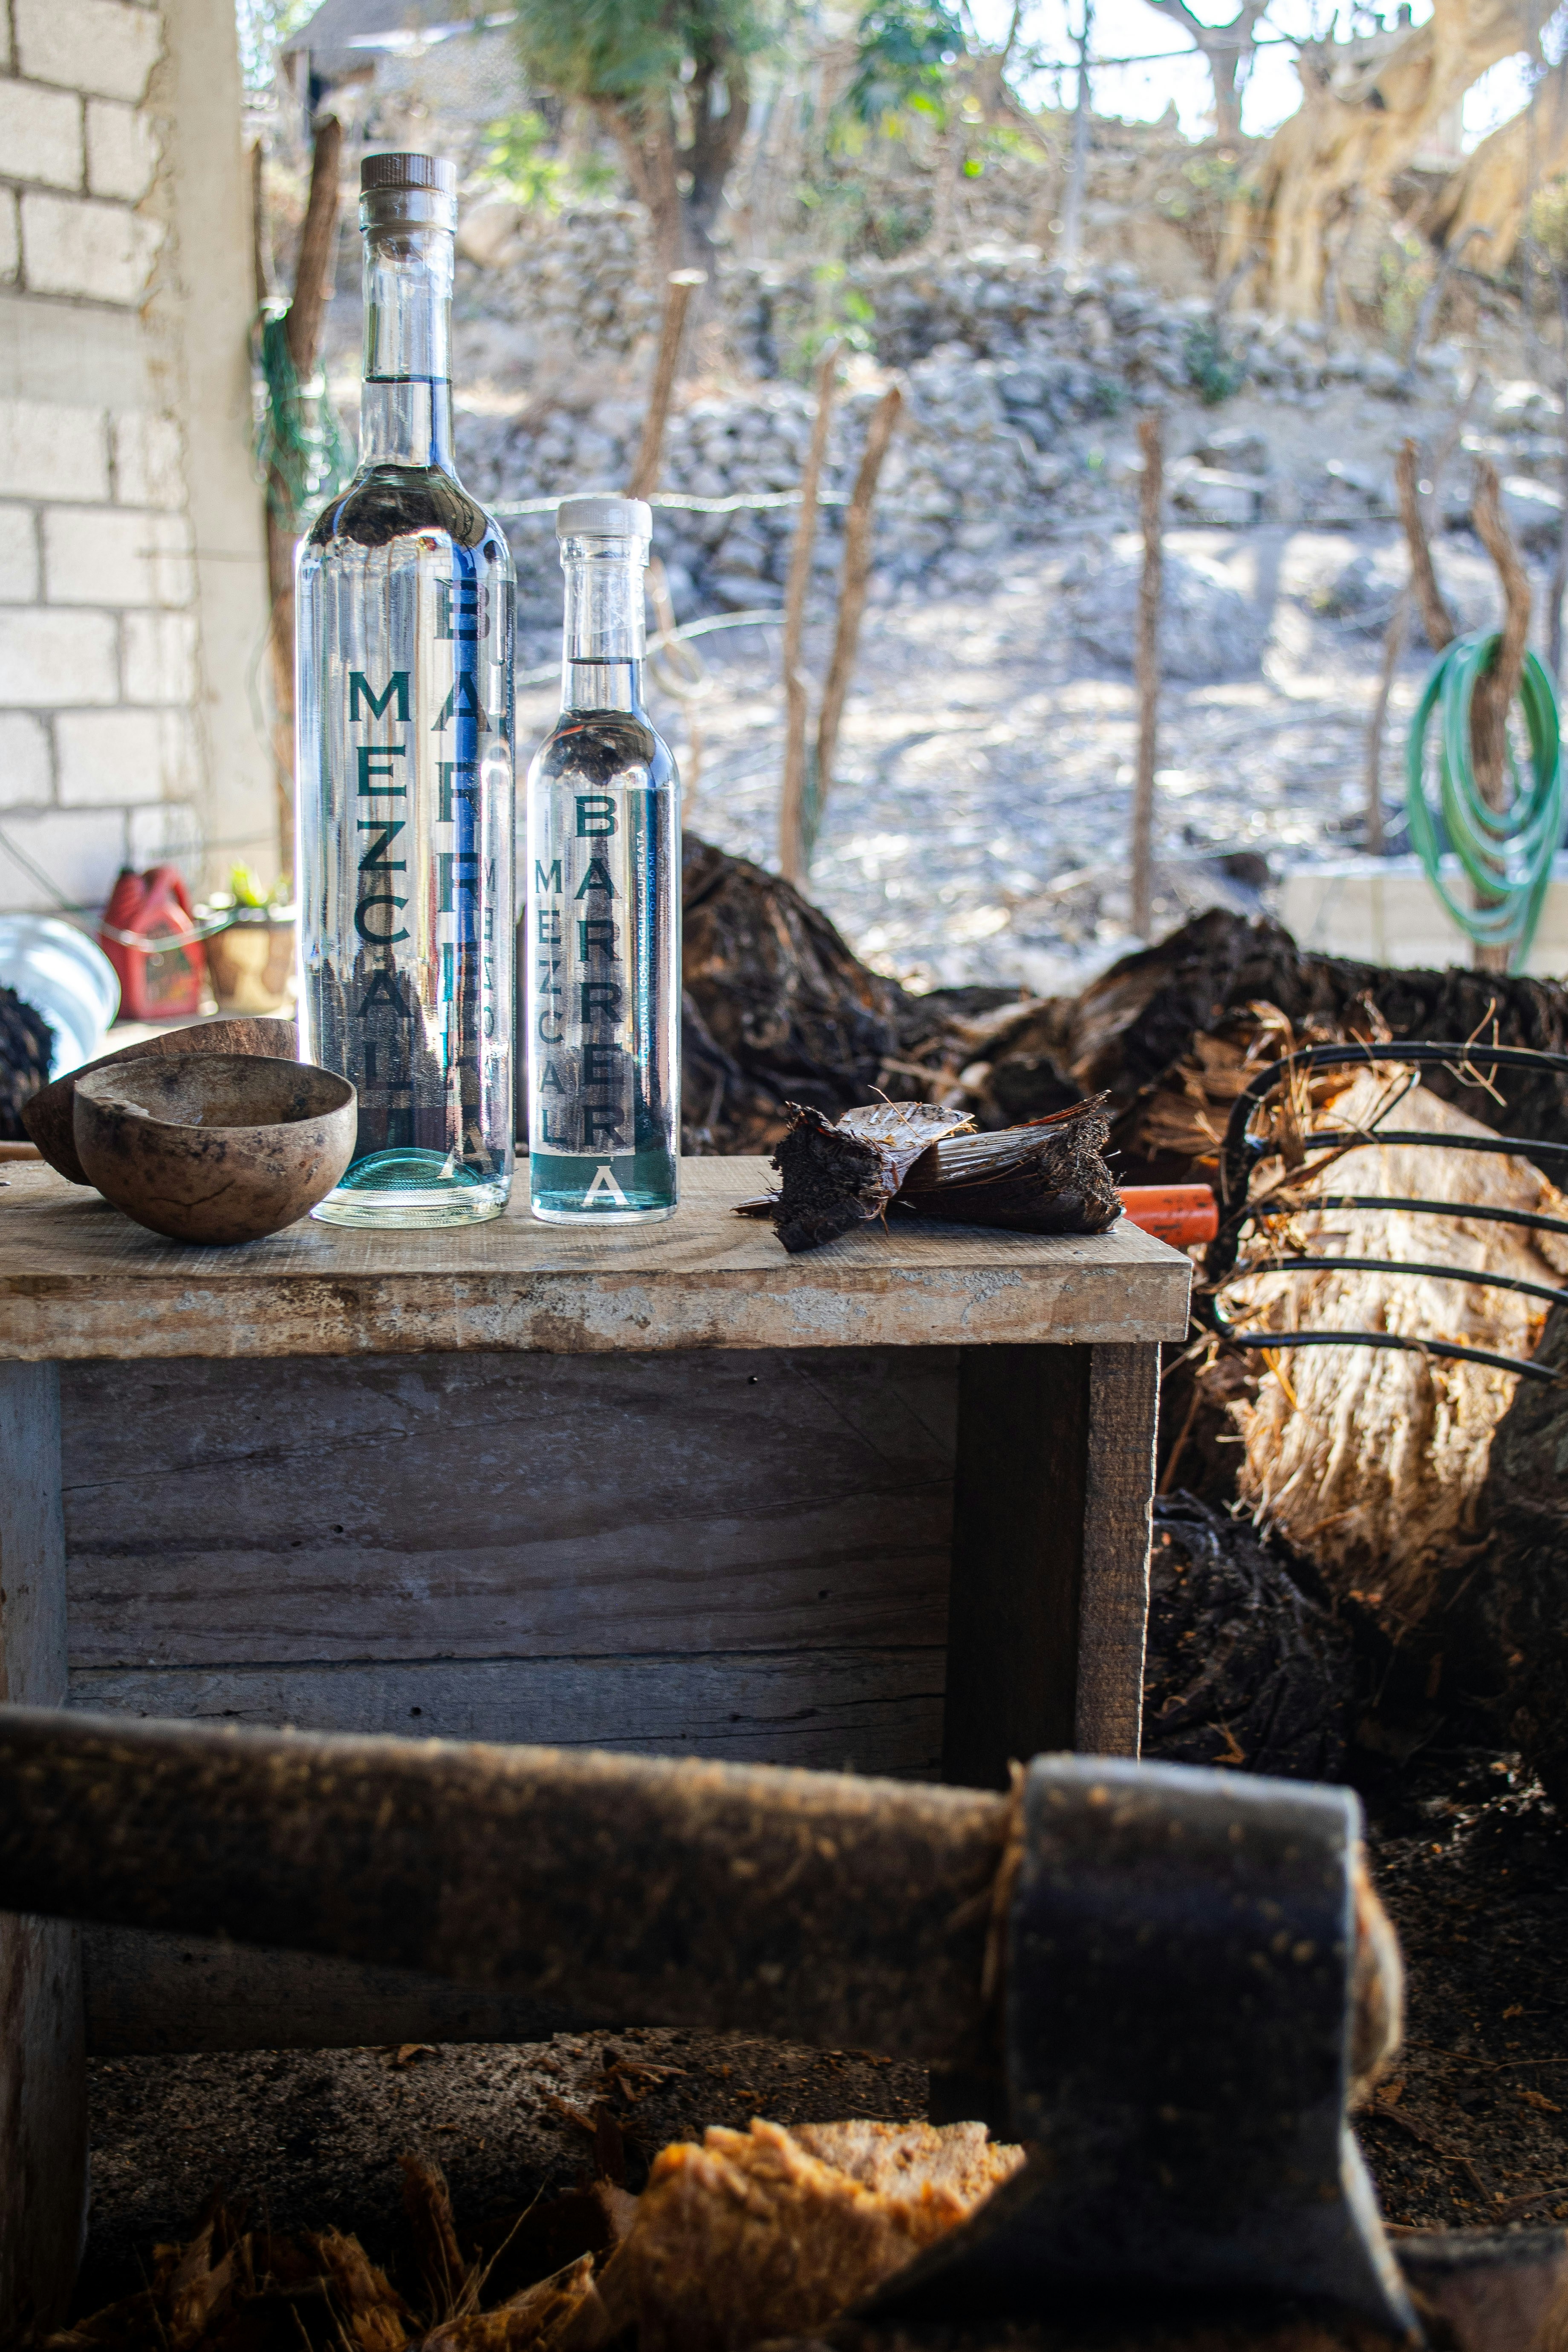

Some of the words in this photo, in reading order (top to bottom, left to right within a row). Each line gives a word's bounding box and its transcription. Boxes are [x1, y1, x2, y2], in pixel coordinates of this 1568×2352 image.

[348, 671, 413, 1091] MEZCAL
[636, 829, 646, 898] CUPREATA
[638, 903, 647, 955] MAGUEY
[535, 860, 566, 1143] MEZCAL
[574, 796, 630, 1206] BARRERA
[638, 960, 648, 992] 100%
[640, 998, 650, 1072] ARTESANAL
